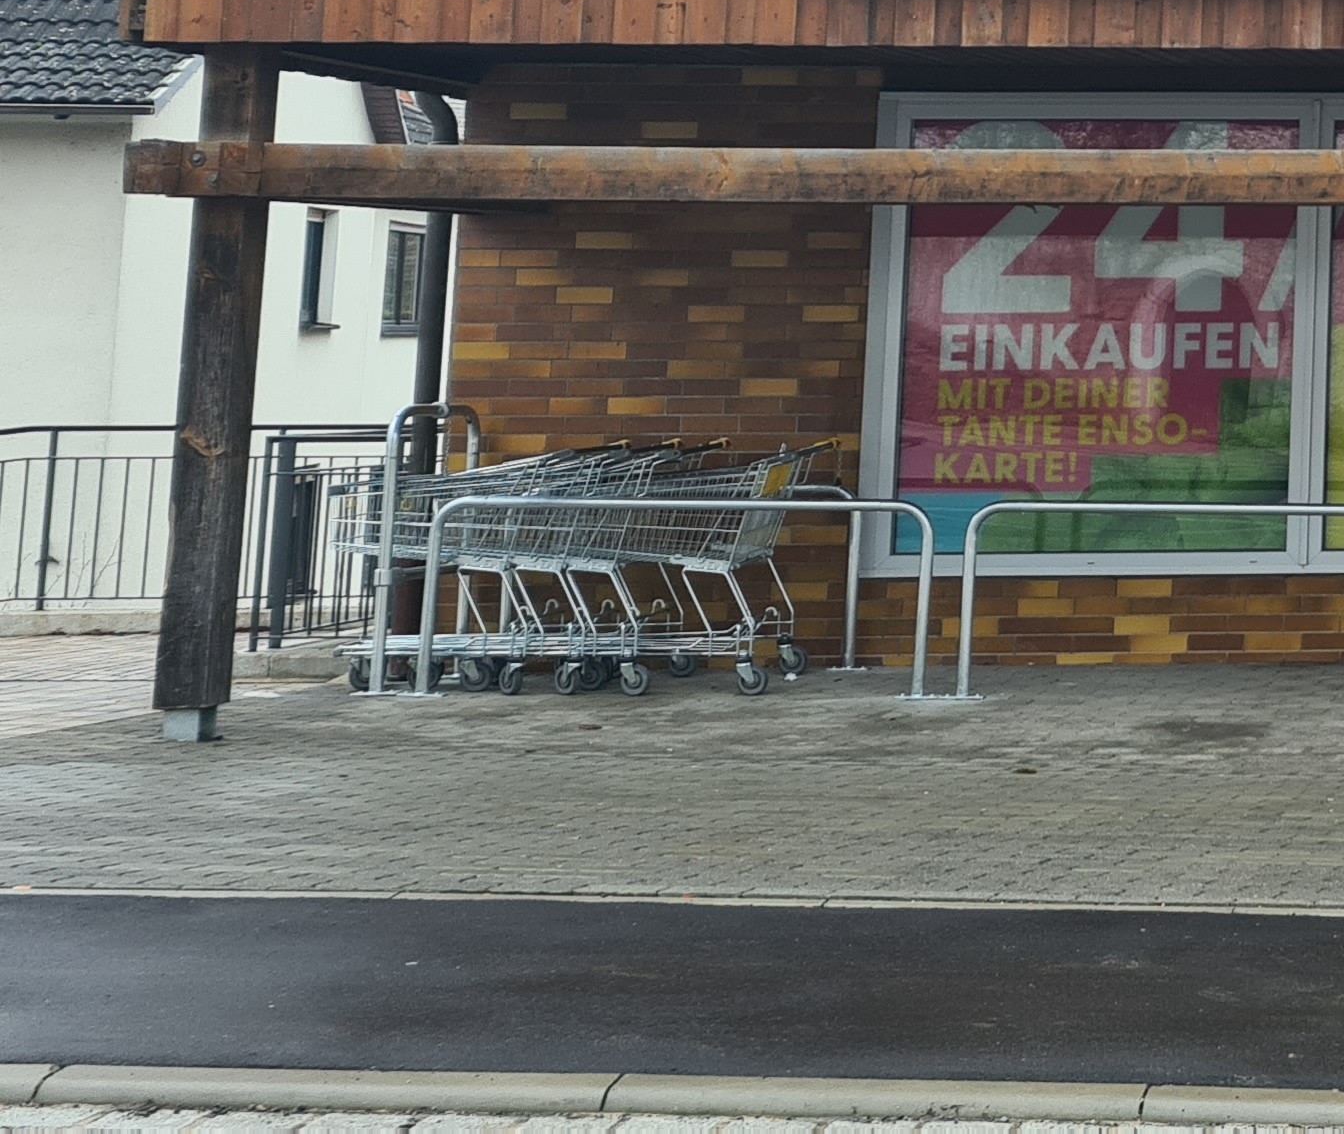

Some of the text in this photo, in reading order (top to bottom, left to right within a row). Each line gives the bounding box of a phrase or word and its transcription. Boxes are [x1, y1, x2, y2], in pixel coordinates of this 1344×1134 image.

[938, 322, 1280, 371] EINKAUFEN
[937, 377, 1171, 411] MIT DEINER
[936, 413, 1207, 447] TANTE ENSO-
[933, 451, 1078, 484] KARTE!
